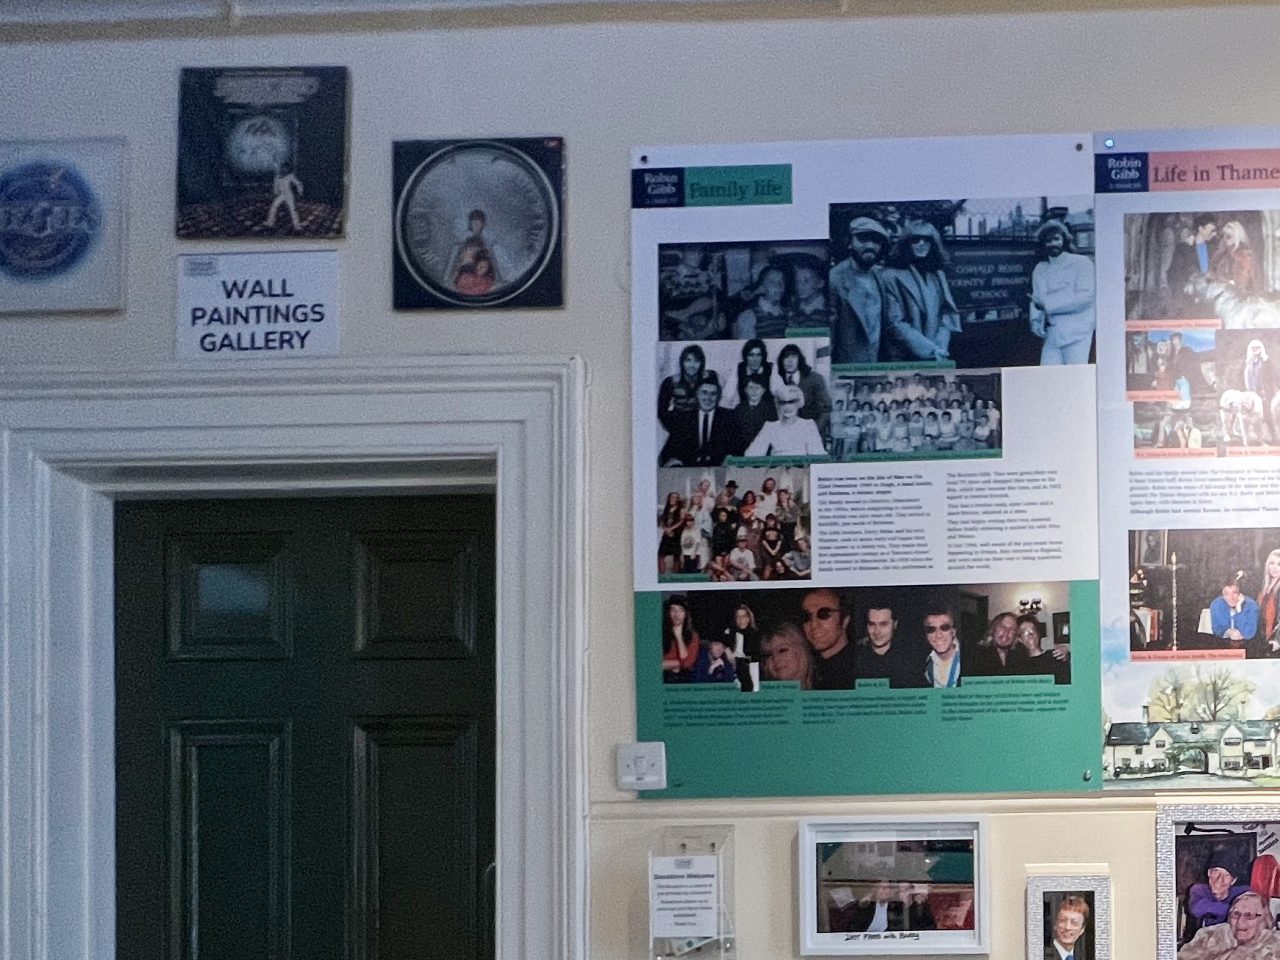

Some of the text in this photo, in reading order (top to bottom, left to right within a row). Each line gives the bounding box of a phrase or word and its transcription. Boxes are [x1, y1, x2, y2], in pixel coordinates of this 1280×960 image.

[1108, 157, 1142, 168] Robin
[1110, 168, 1140, 180] Gibb
[1153, 164, 1280, 183] Life in Thame
[689, 178, 783, 201] Family life
[221, 278, 294, 299] WALL
[190, 303, 325, 326] PAINTINGS
[200, 329, 311, 352] GALLERY
